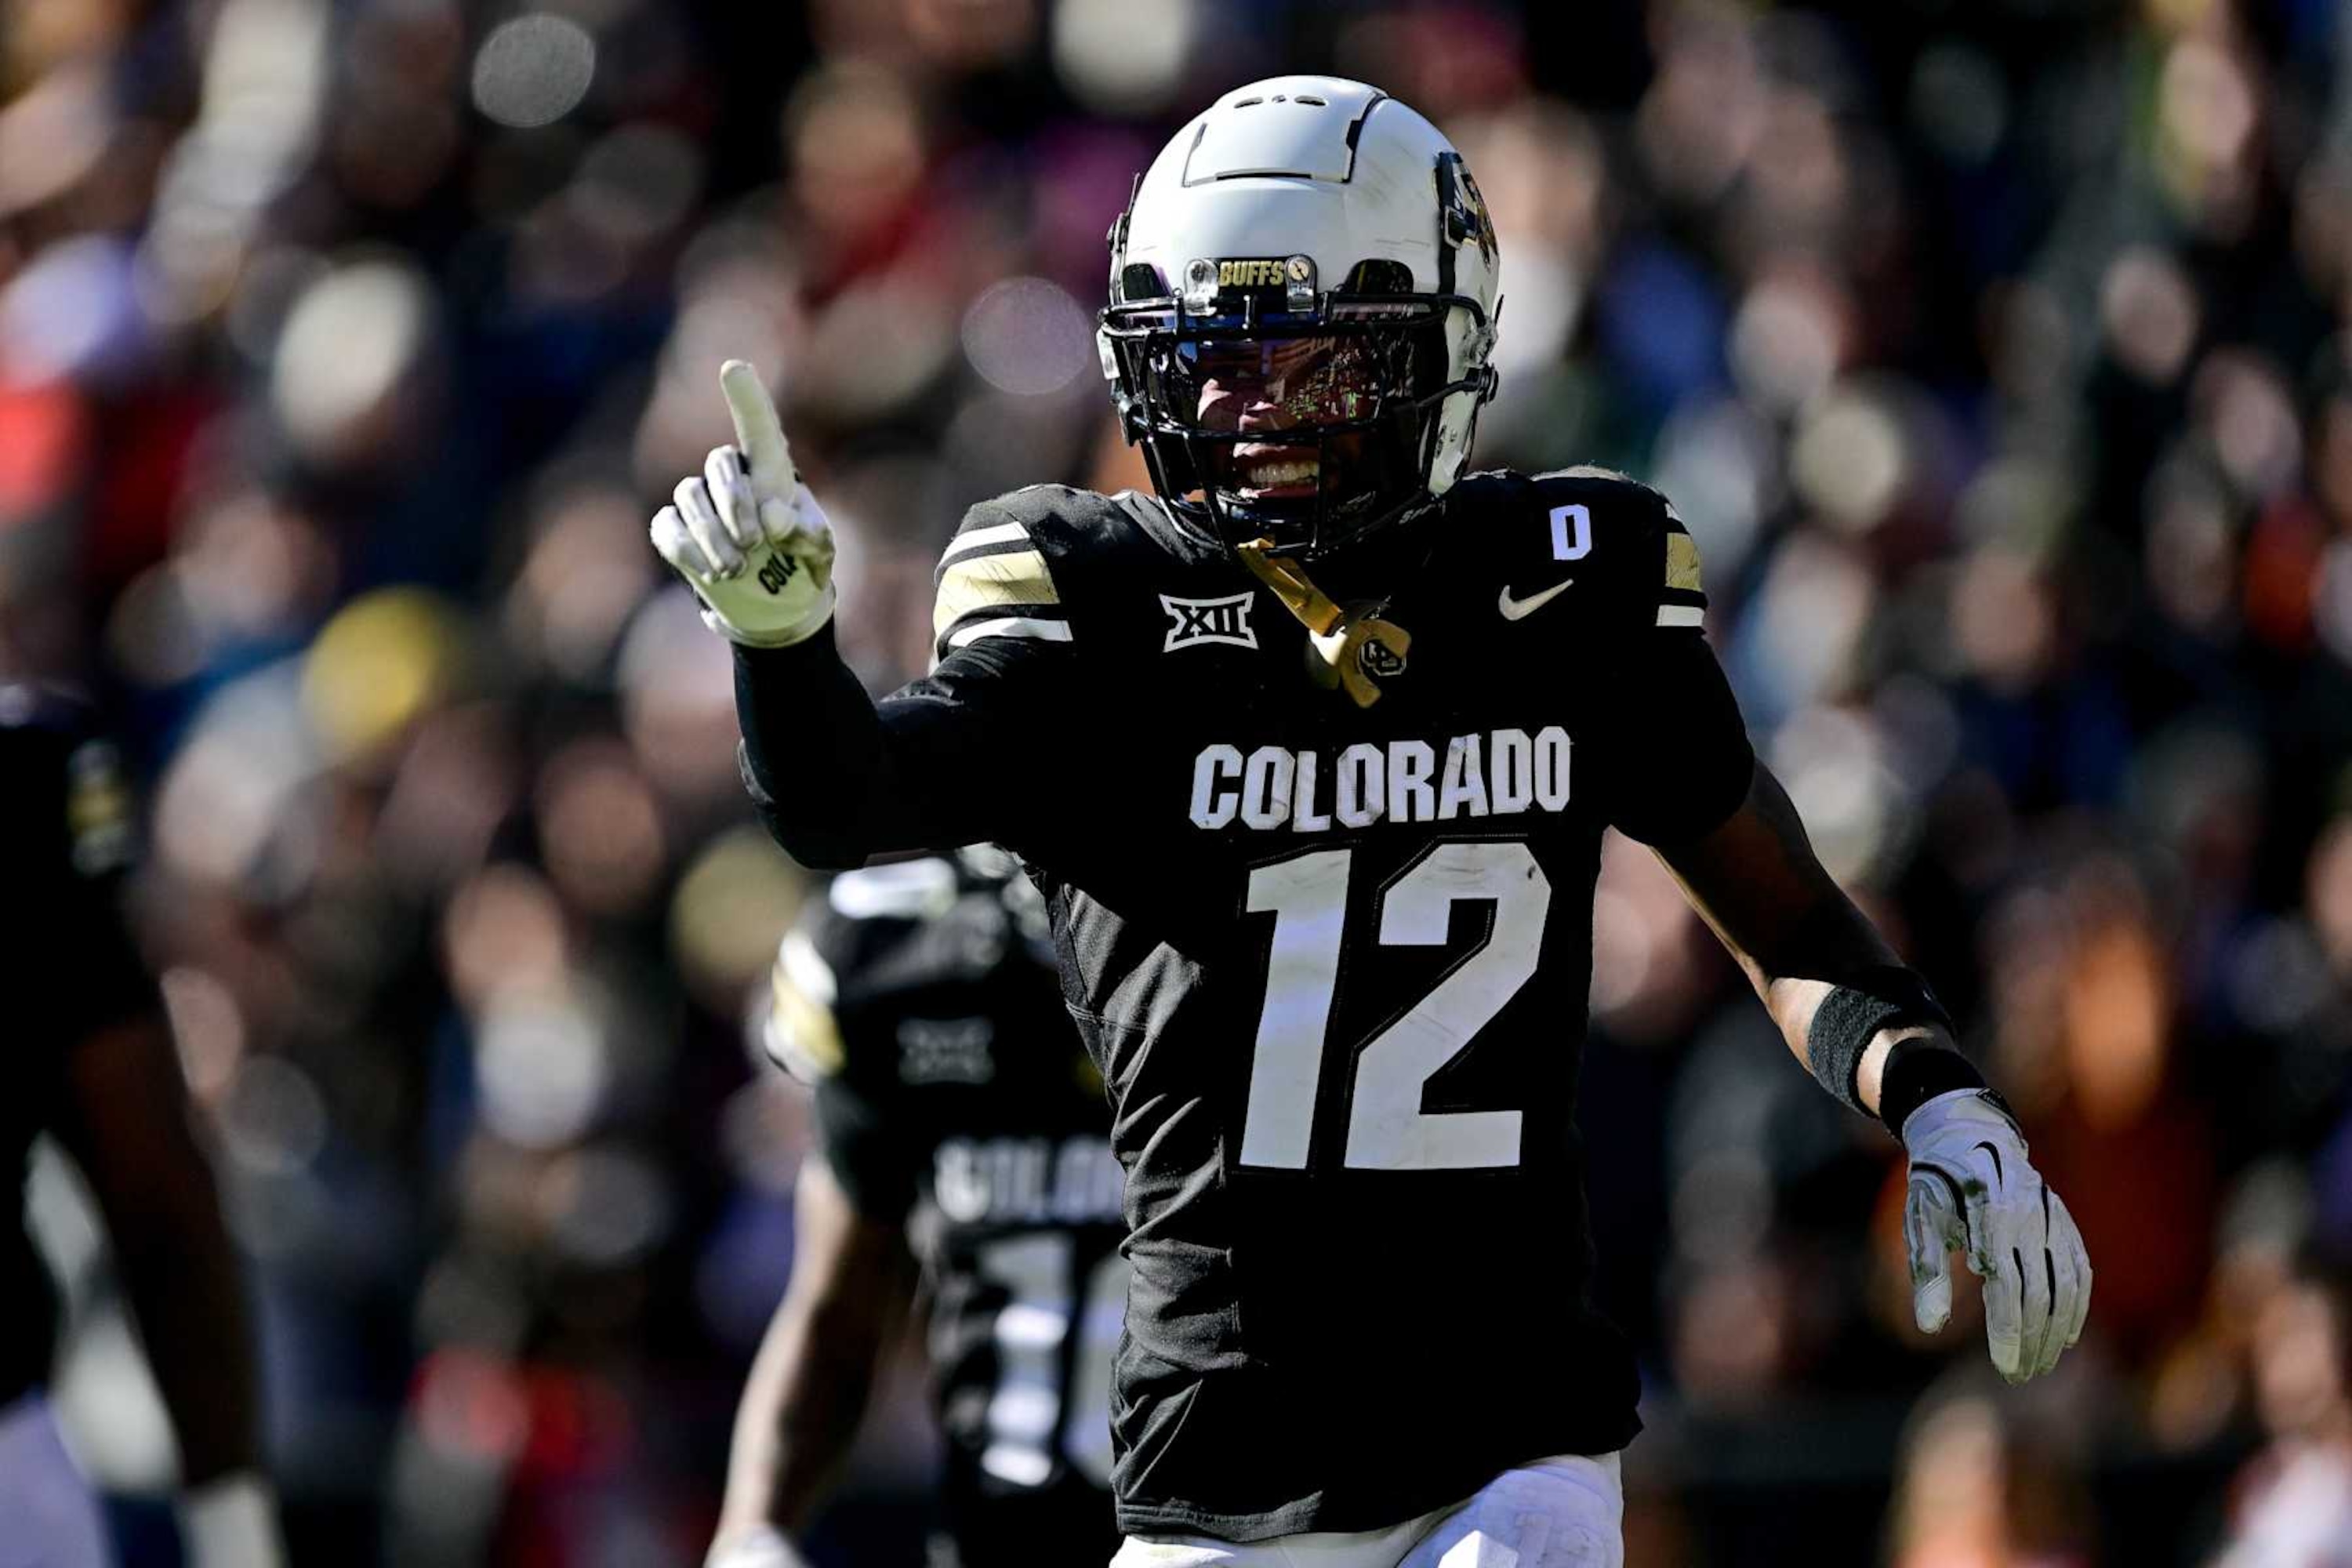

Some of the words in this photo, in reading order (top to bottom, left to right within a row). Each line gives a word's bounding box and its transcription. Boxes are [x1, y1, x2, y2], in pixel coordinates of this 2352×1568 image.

[1219, 260, 1284, 287] BUFFS
[1549, 504, 1592, 561] D
[1189, 726, 1570, 833] COLORADO
[1240, 842, 1552, 1170] 12
